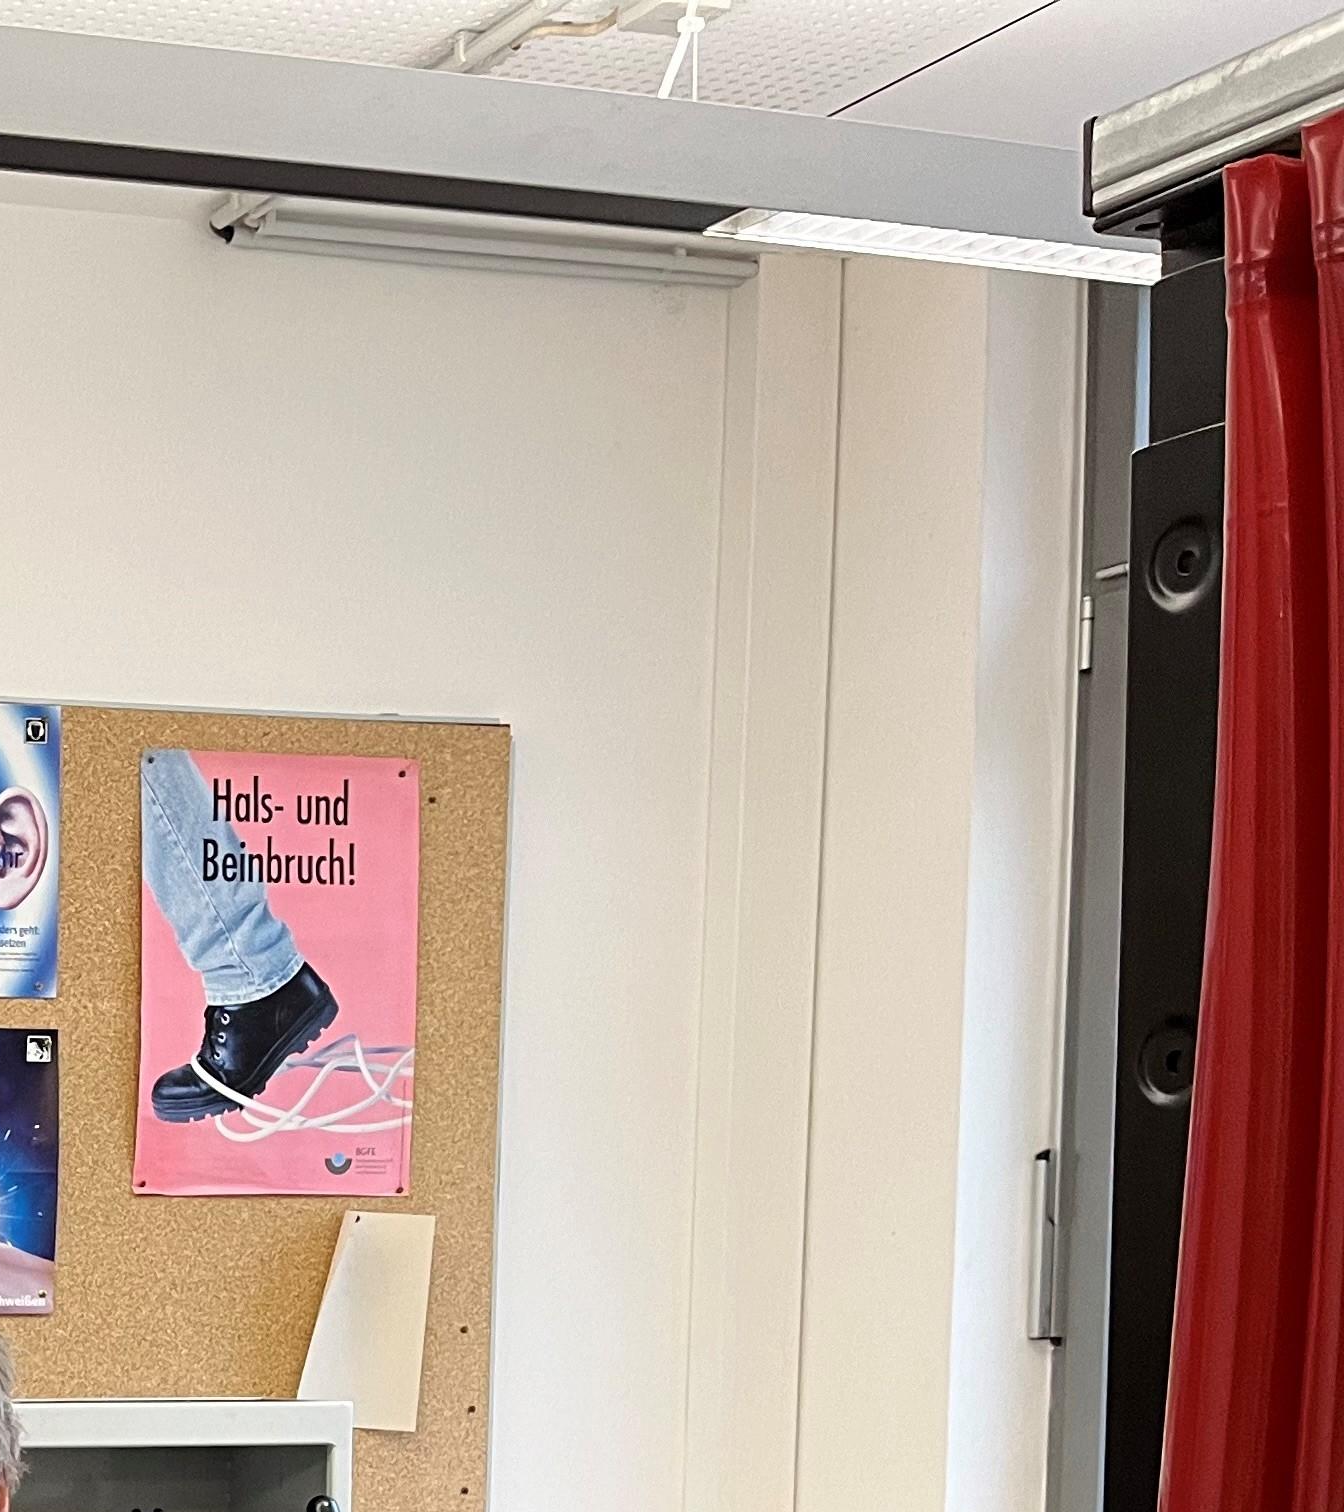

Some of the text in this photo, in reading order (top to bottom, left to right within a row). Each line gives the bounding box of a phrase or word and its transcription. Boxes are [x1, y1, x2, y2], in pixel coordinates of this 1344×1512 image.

[212, 775, 349, 826] Hals- und
[202, 836, 356, 886] Beinbruch!
